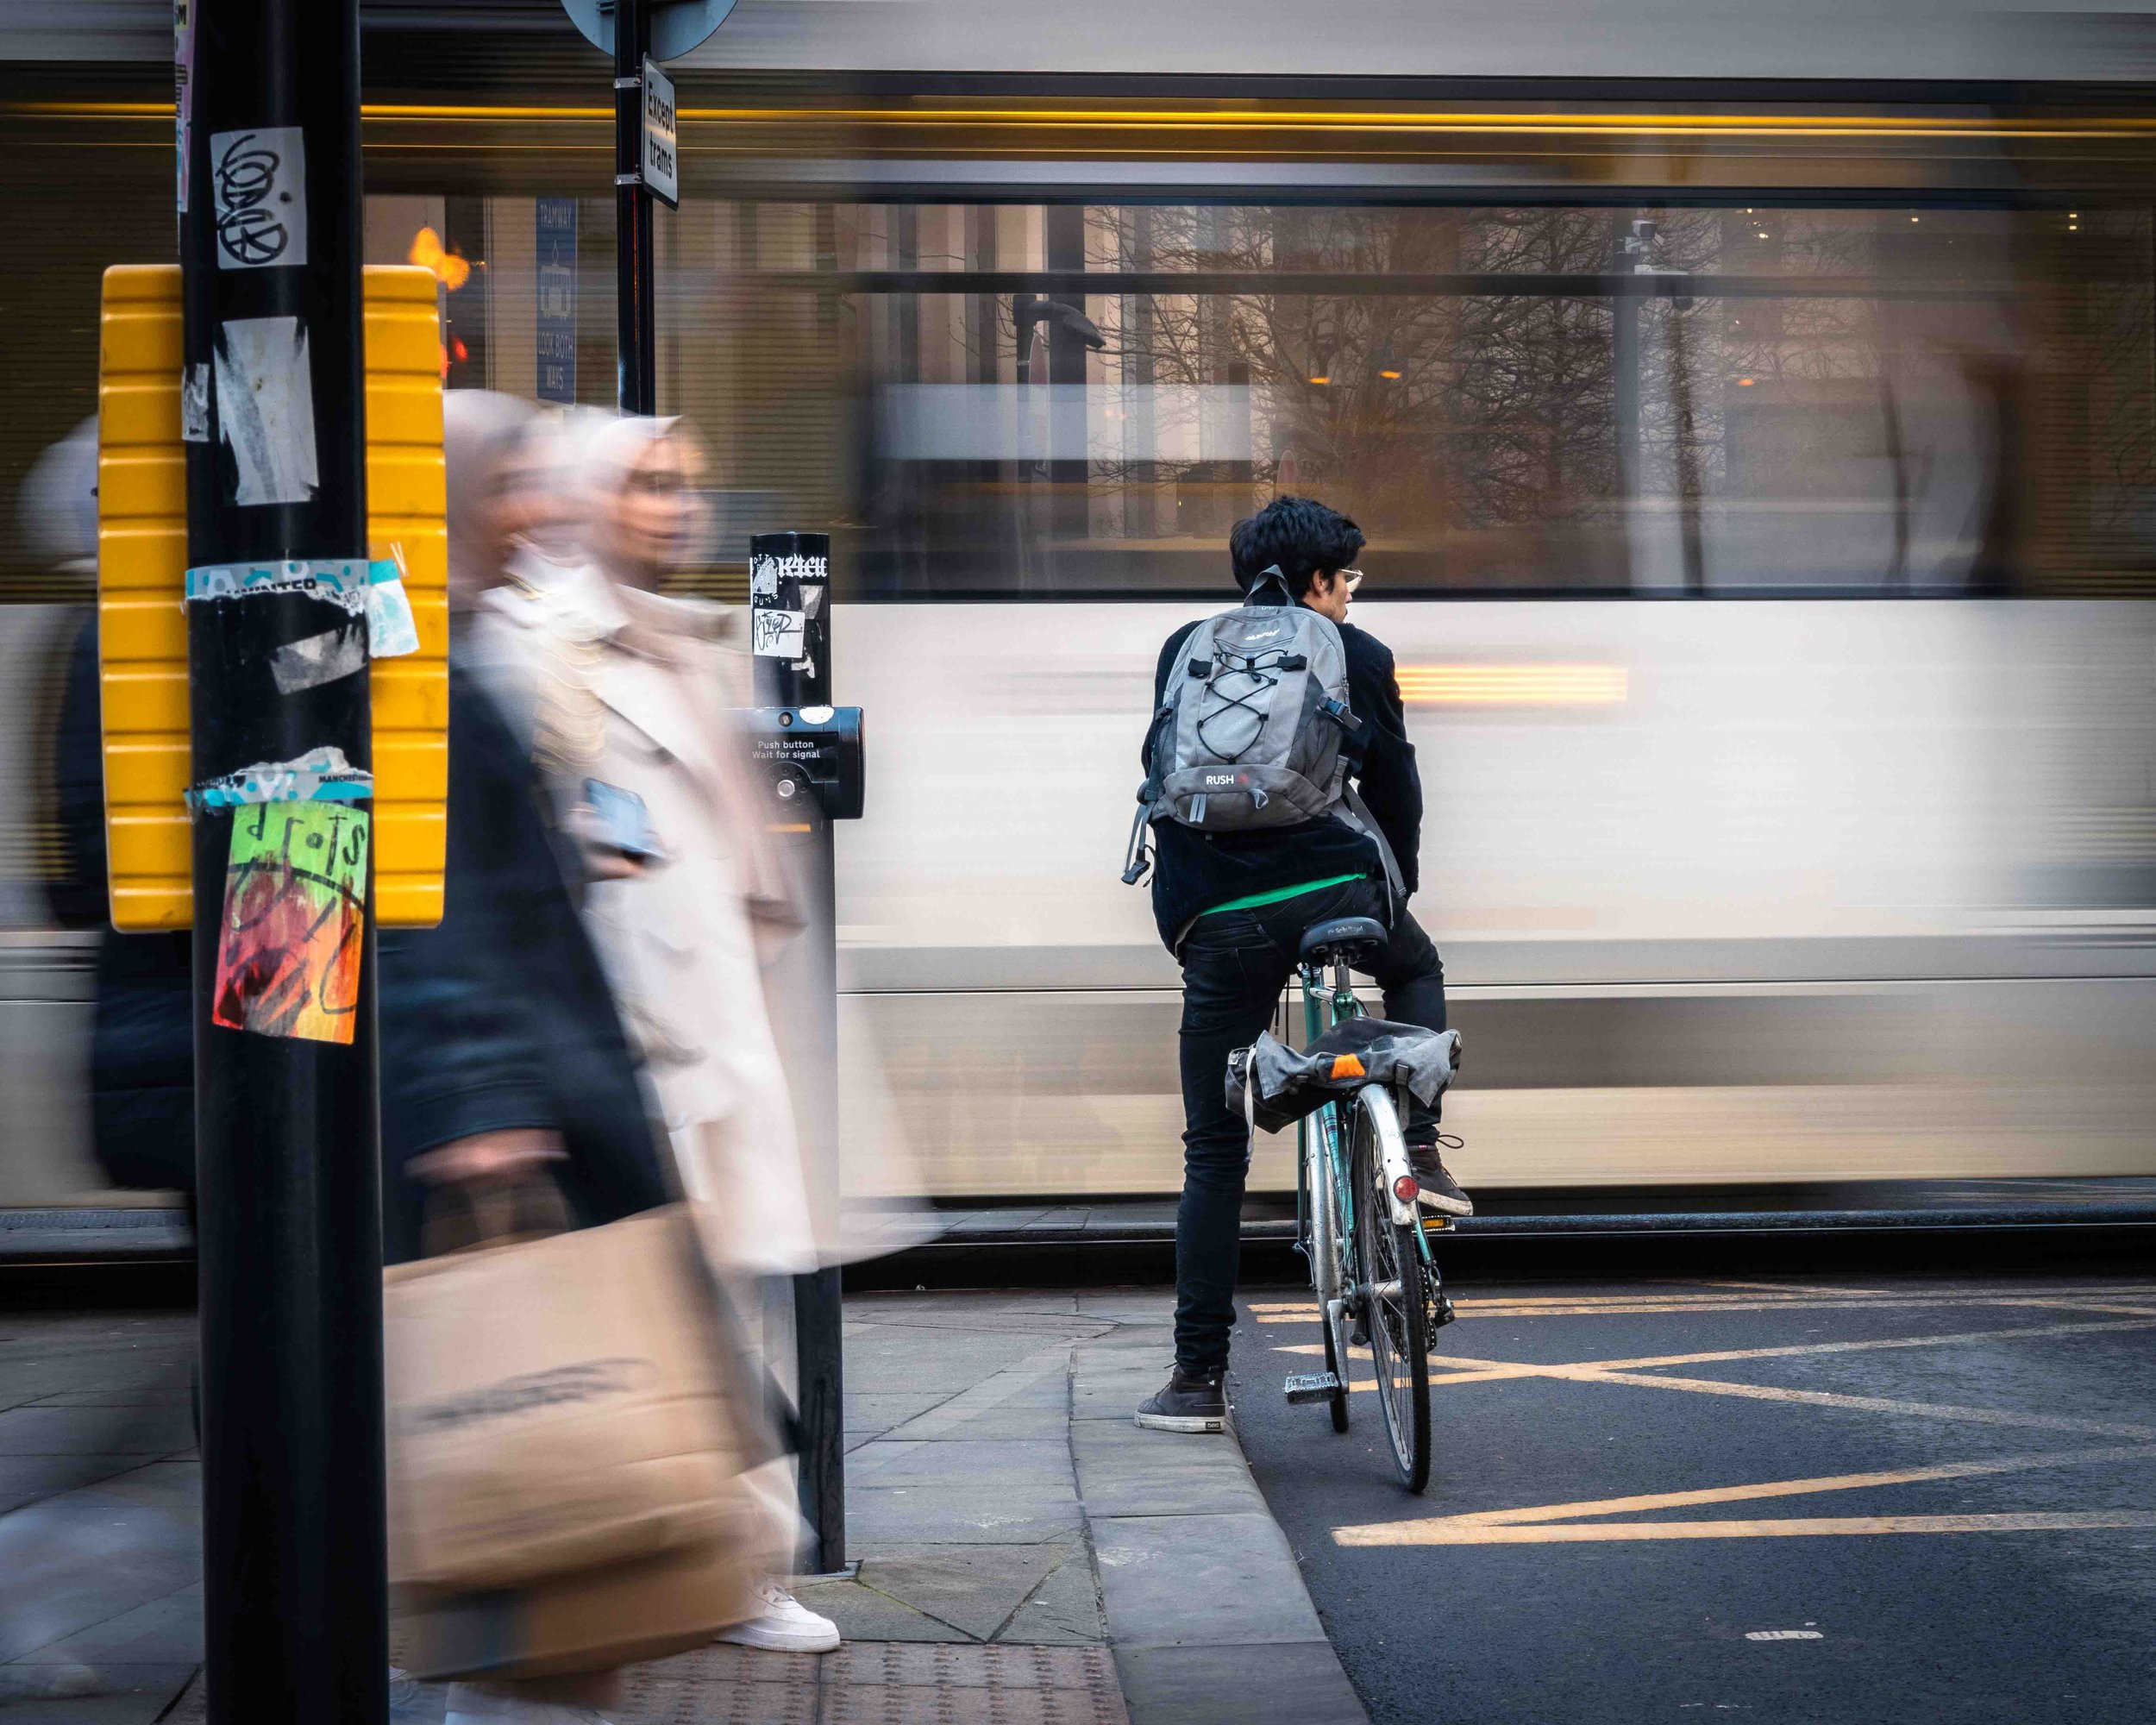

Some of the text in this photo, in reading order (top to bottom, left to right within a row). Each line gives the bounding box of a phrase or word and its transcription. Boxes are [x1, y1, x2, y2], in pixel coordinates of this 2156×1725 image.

[648, 80, 674, 135] Except
[649, 131, 673, 179] trams
[538, 331, 573, 360] LOOK BOTH
[546, 365, 564, 391] WAYS
[752, 750, 820, 760] Wait for signal
[758, 741, 780, 750] Push
[1206, 775, 1234, 785] RUSH
